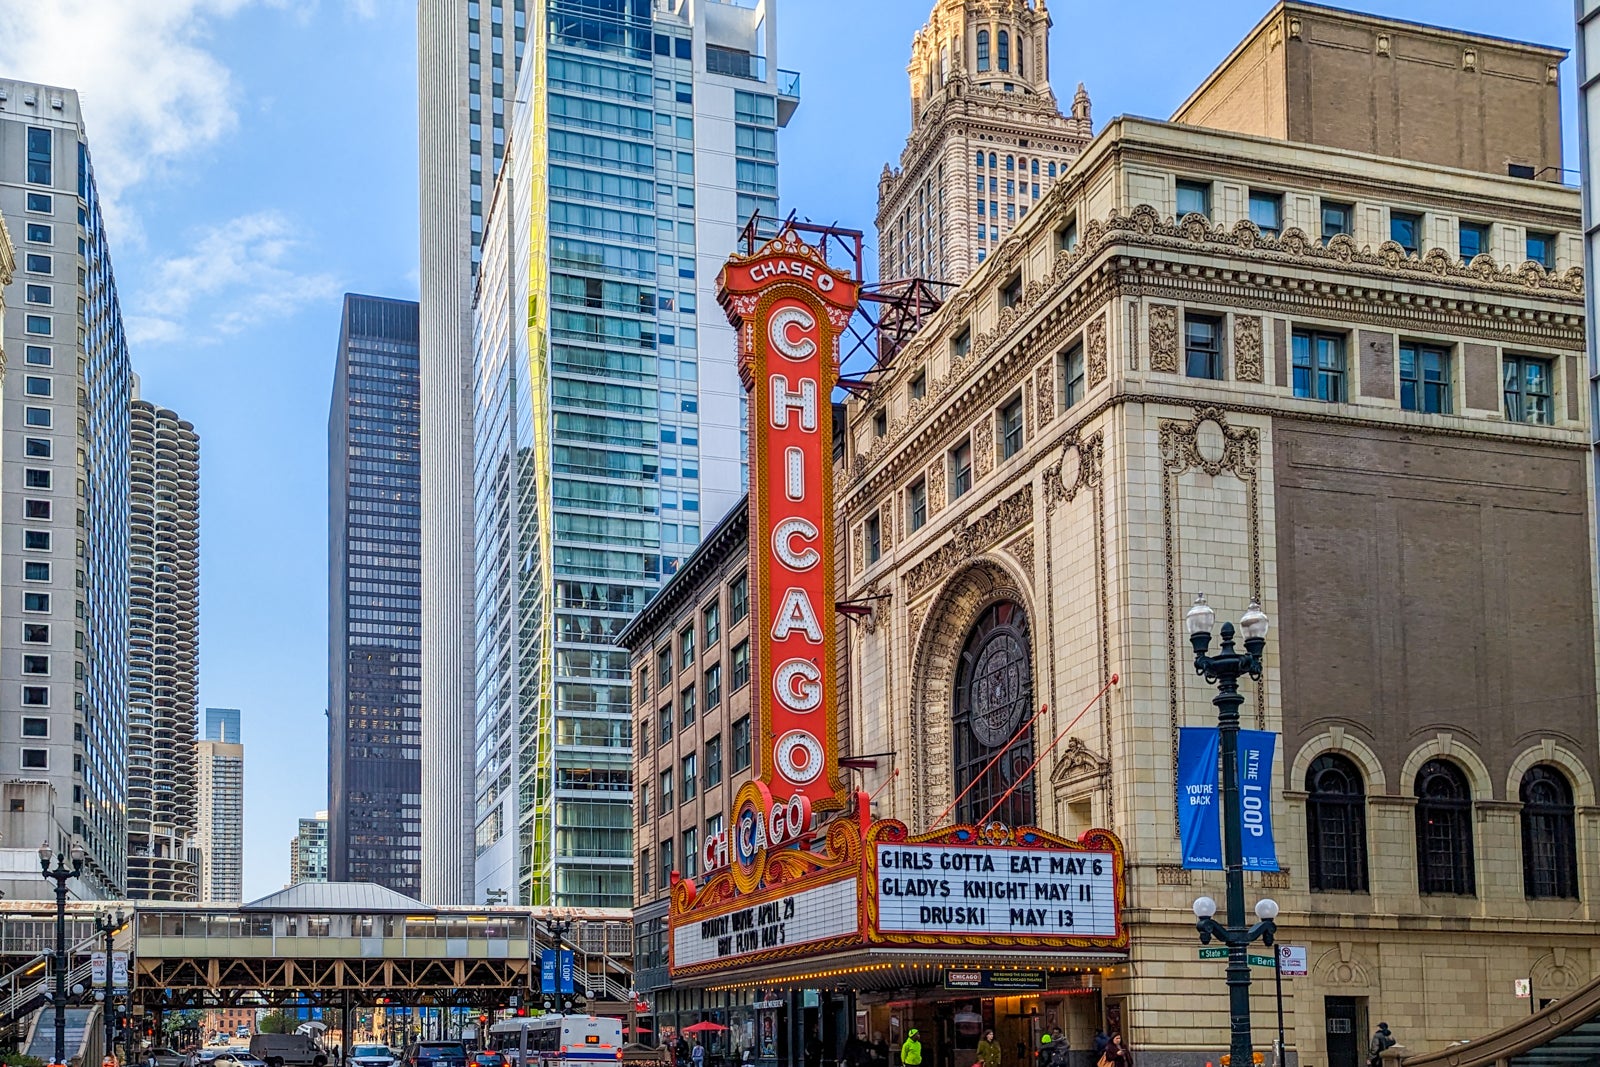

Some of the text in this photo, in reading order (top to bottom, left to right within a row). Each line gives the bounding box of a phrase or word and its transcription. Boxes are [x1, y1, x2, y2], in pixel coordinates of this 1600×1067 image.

[750, 260, 815, 282] CHASE
[768, 306, 825, 786] CHICAGO
[1186, 784, 1213, 794] YOU'RE
[1243, 750, 1264, 837] IN THE LOOP
[1190, 796, 1211, 806] BACK
[703, 794, 804, 871] CHICAGO
[881, 850, 1103, 876] GIRLS GOTTA EAT MAY 6
[882, 878, 1091, 902] GLADYS KNIGHT MAY 11
[758, 901, 781, 926] APRIL
[920, 906, 1074, 927] DRUSKI MAY 13
[762, 924, 778, 948] MAY
[1205, 950, 1221, 958] State
[1257, 957, 1276, 966] Bent
[562, 964, 571, 982] LOOP
